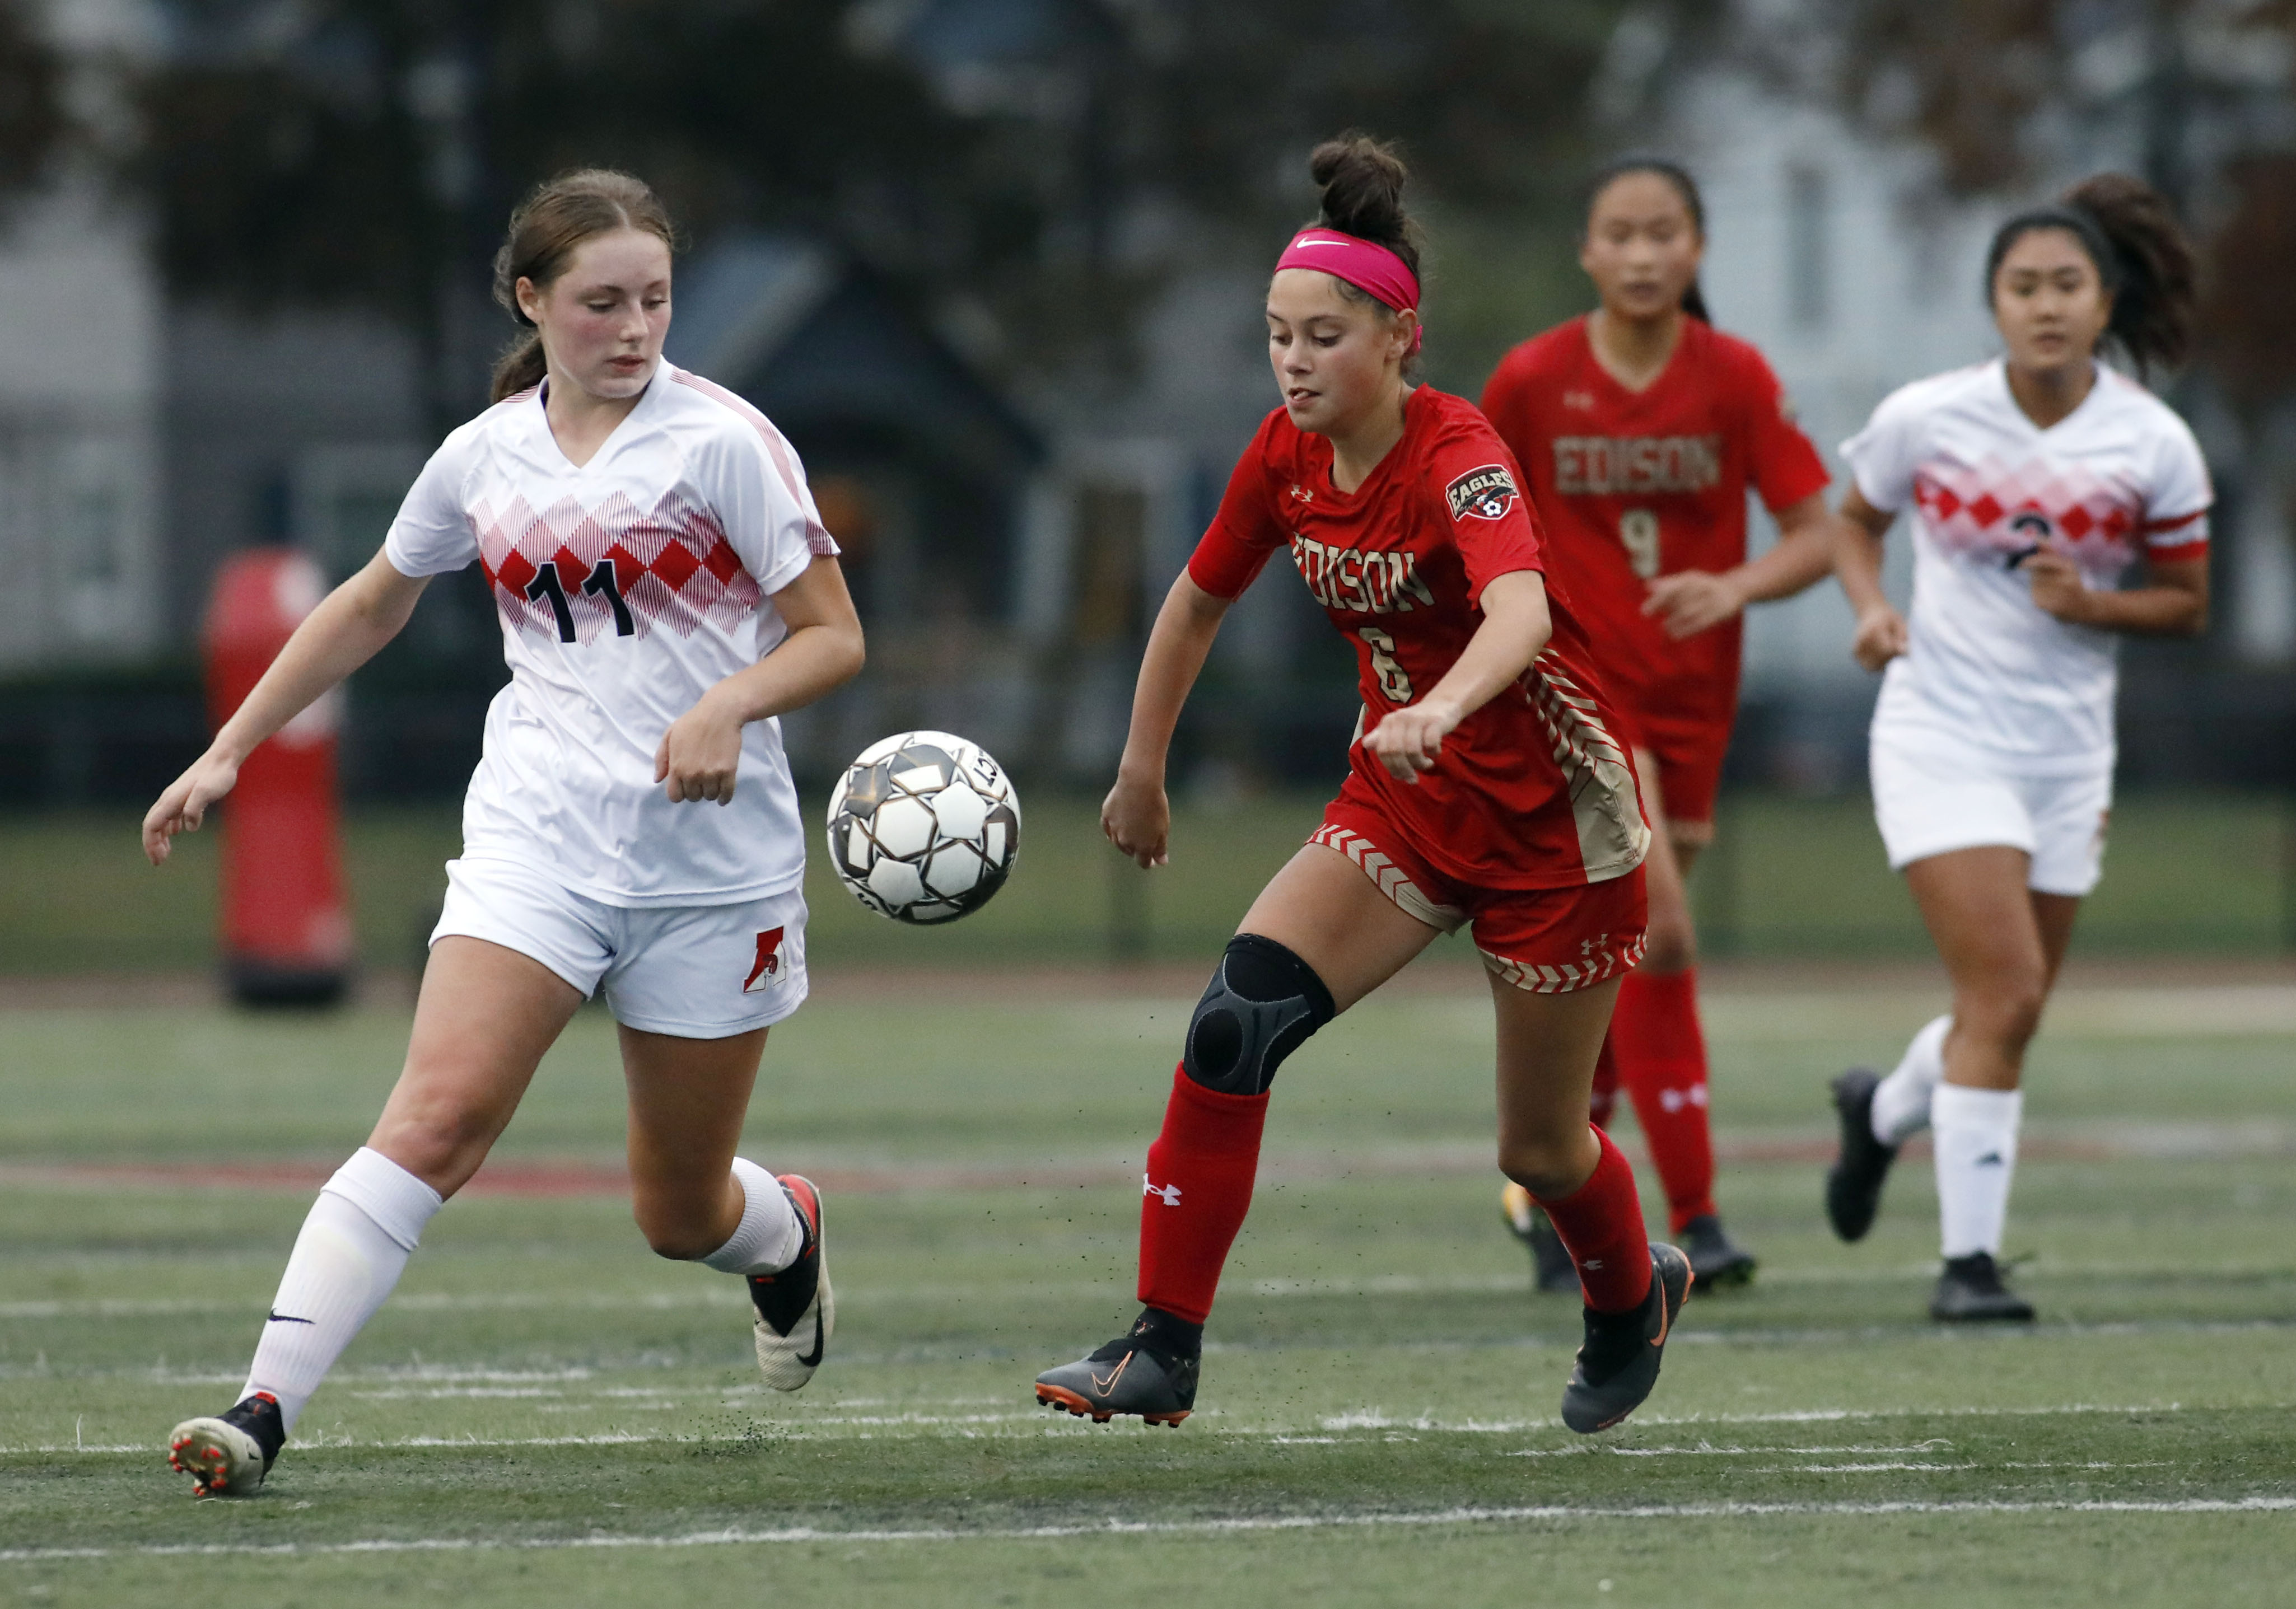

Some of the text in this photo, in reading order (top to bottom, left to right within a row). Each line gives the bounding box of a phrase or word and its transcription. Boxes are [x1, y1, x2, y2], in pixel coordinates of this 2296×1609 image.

[1449, 471, 1515, 516] EAGLES
[1620, 508, 1660, 580] 9
[524, 559, 634, 643] 11
[1359, 627, 1413, 704] 6
